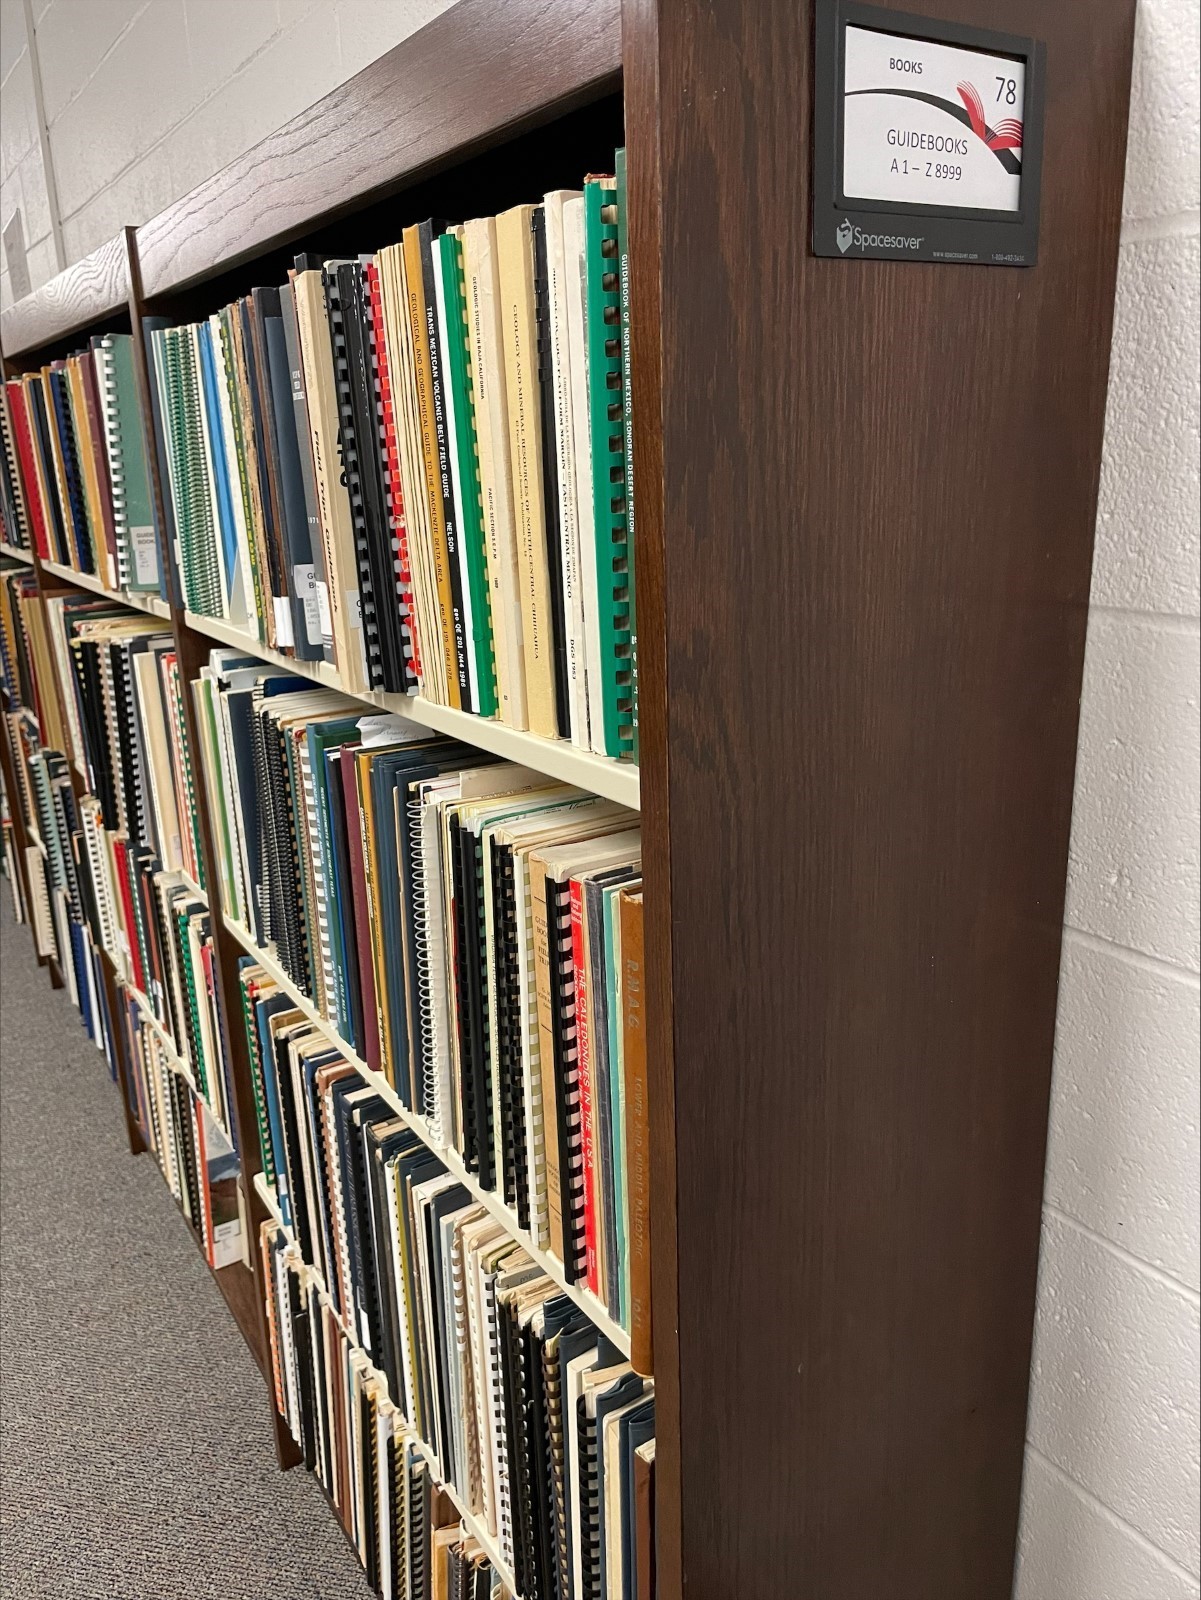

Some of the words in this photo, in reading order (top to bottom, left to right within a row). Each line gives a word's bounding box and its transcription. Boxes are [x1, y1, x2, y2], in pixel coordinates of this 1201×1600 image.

[890, 58, 922, 74] BOOKS
[995, 76, 1016, 104] 78
[887, 129, 968, 155] GUIDEBOOKS
[890, 158, 898, 173] A
[903, 160, 908, 174] 1
[926, 162, 932, 177] Z
[935, 164, 962, 180] 8999
[854, 226, 922, 252] Spacesaver
[411, 293, 421, 344] GEOLOGICAL
[426, 306, 435, 335] TRANS
[623, 311, 629, 322] OF
[429, 338, 439, 378] MEXICAN
[417, 368, 429, 428] GEOGRAPHICAL
[432, 380, 443, 422] VOLCANIC
[517, 387, 525, 434] MINERAL
[424, 432, 432, 456] GUIDE
[436, 424, 445, 444] BELT
[426, 459, 433, 470] TO
[438, 446, 447, 470] FIELD
[520, 438, 530, 496] RESOURCES
[440, 473, 450, 498] GUIDE
[430, 490, 440, 535] MACKENZIE
[524, 499, 531, 513] OF
[446, 522, 454, 552] NELSON
[326, 528, 337, 611] Guidebook
[526, 516, 535, 598] NORTH-CENTRAL
[454, 623, 462, 633] QE
[530, 602, 539, 659] CHIHUAHUA
[580, 996, 590, 1087] CALEDONIDES
[583, 1090, 590, 1106] IN
